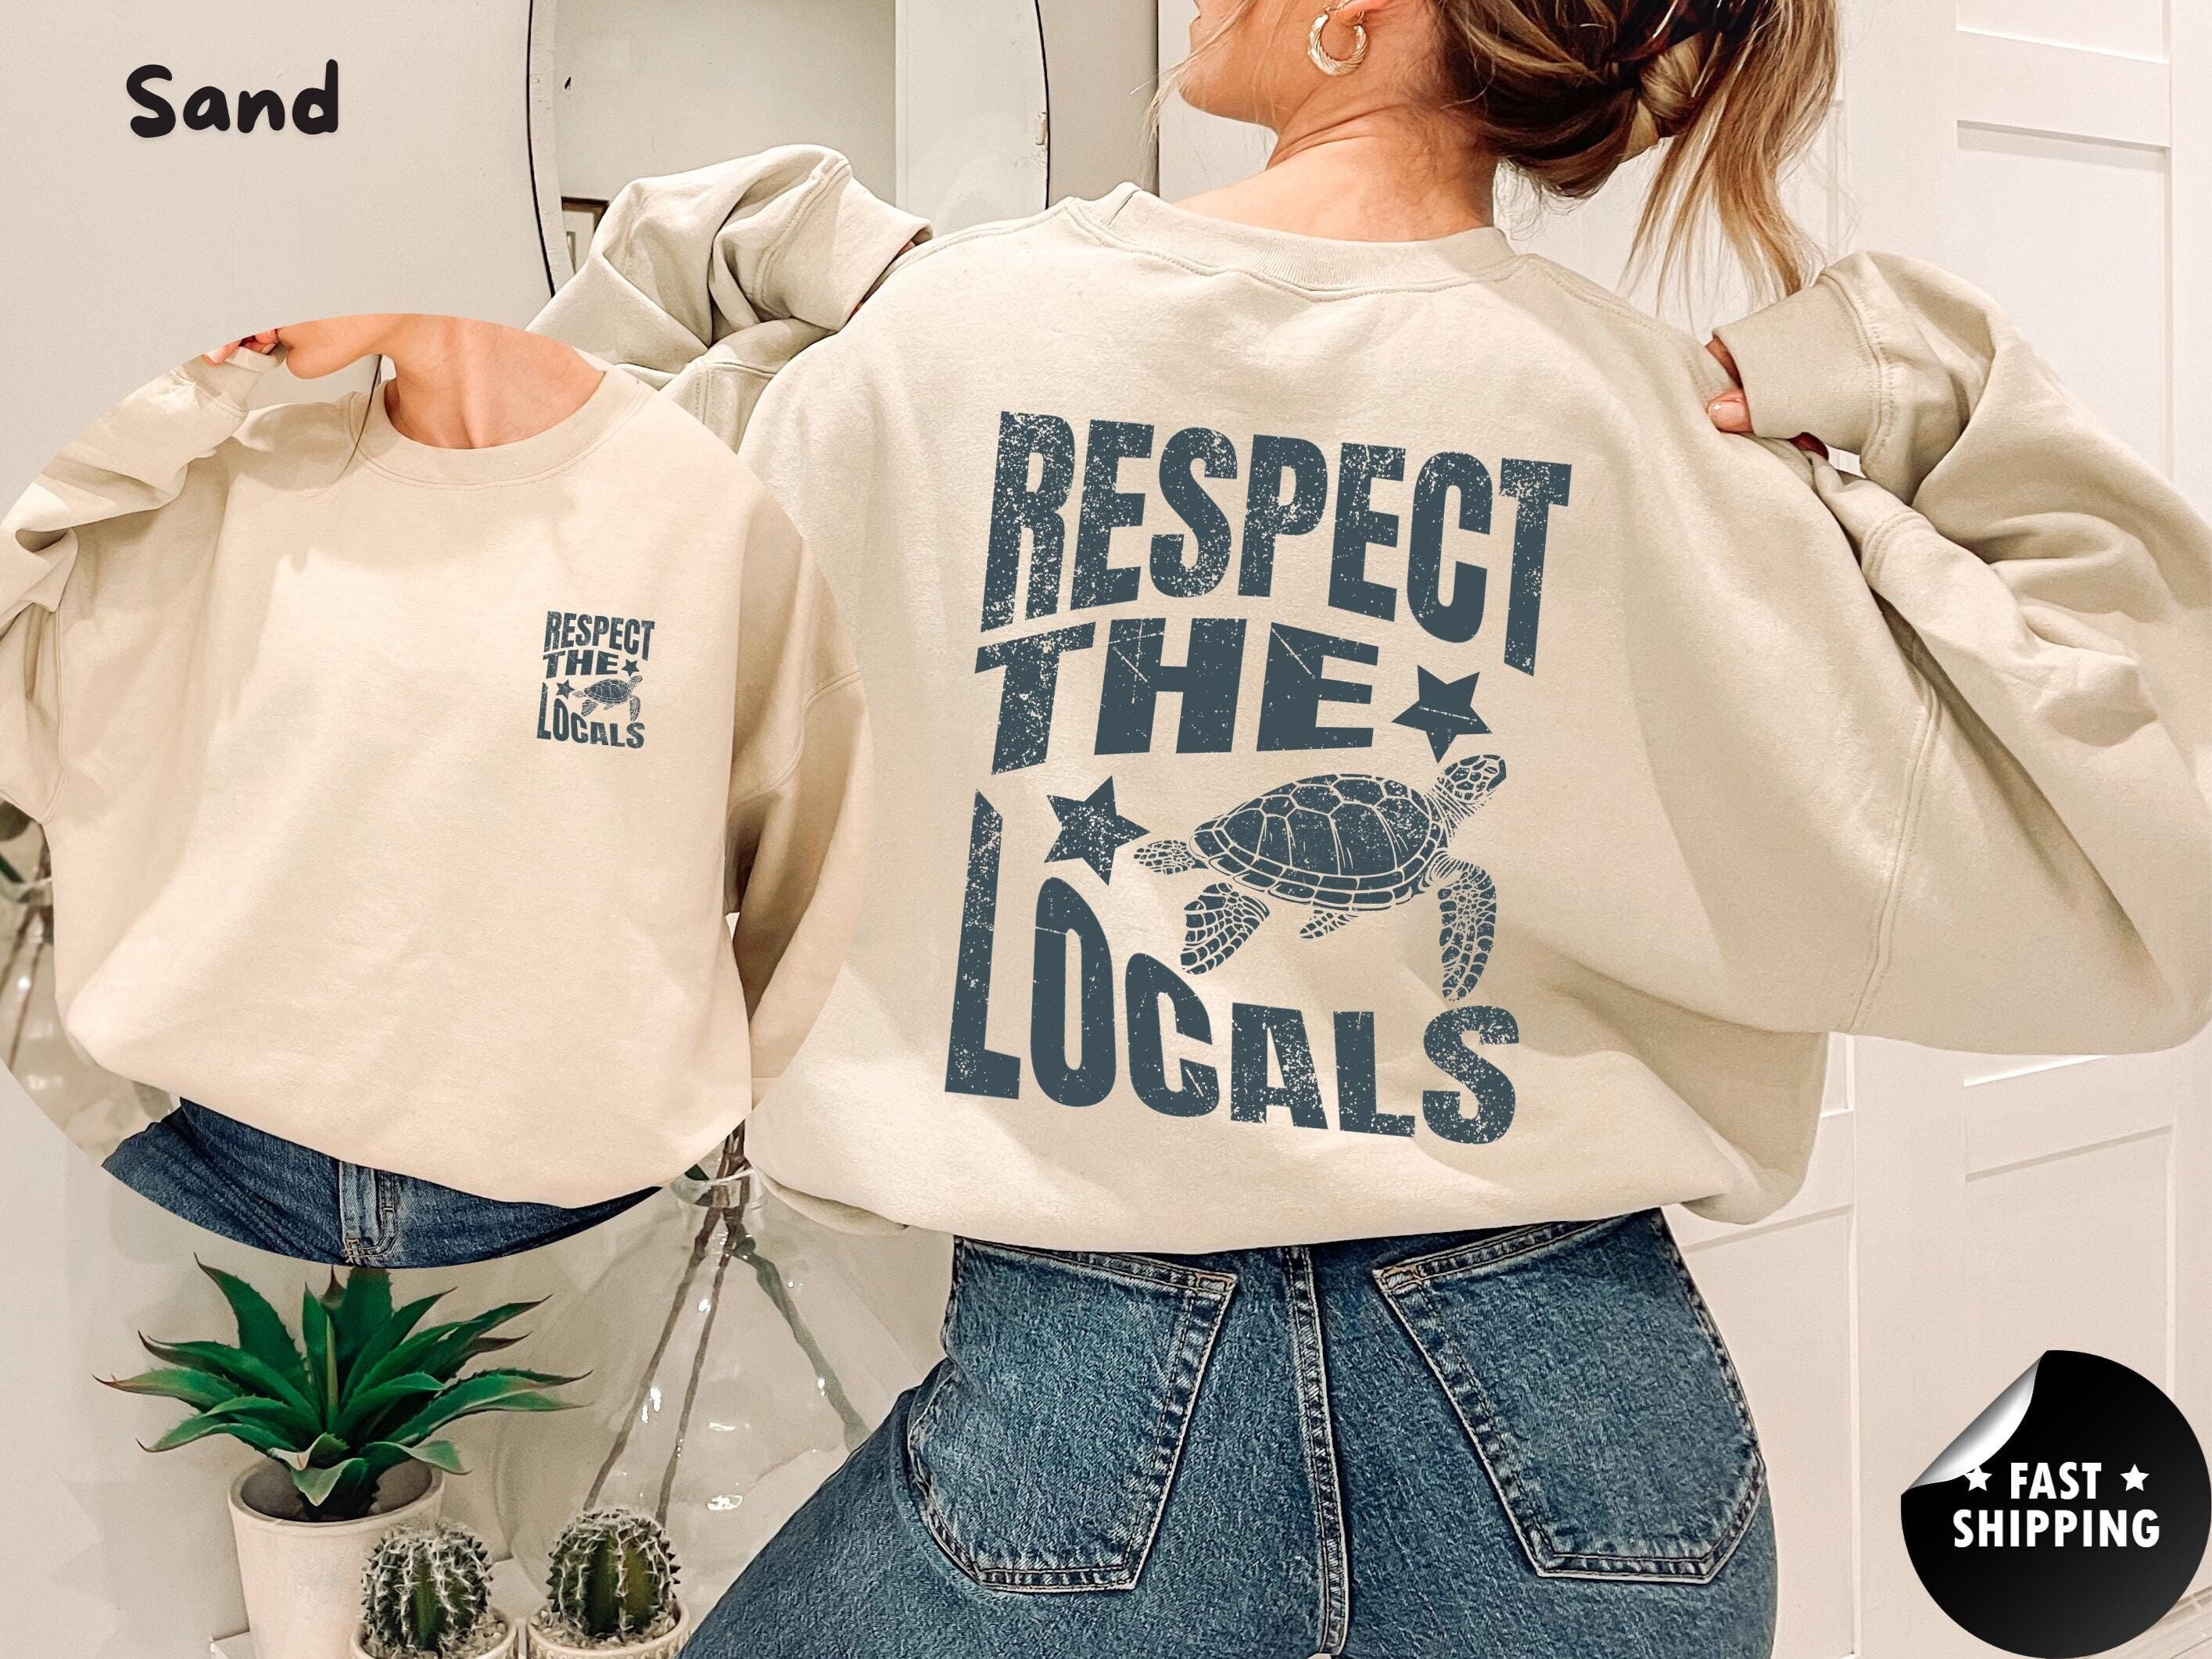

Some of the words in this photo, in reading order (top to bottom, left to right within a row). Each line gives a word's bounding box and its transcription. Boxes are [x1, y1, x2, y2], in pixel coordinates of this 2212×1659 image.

[981, 410, 1572, 677] RESPECT
[542, 649, 619, 679] THE
[544, 611, 655, 661] RESPECT
[536, 682, 645, 749] LOCALS
[974, 618, 1379, 776] THE
[944, 790, 1520, 1145] LOCALS
